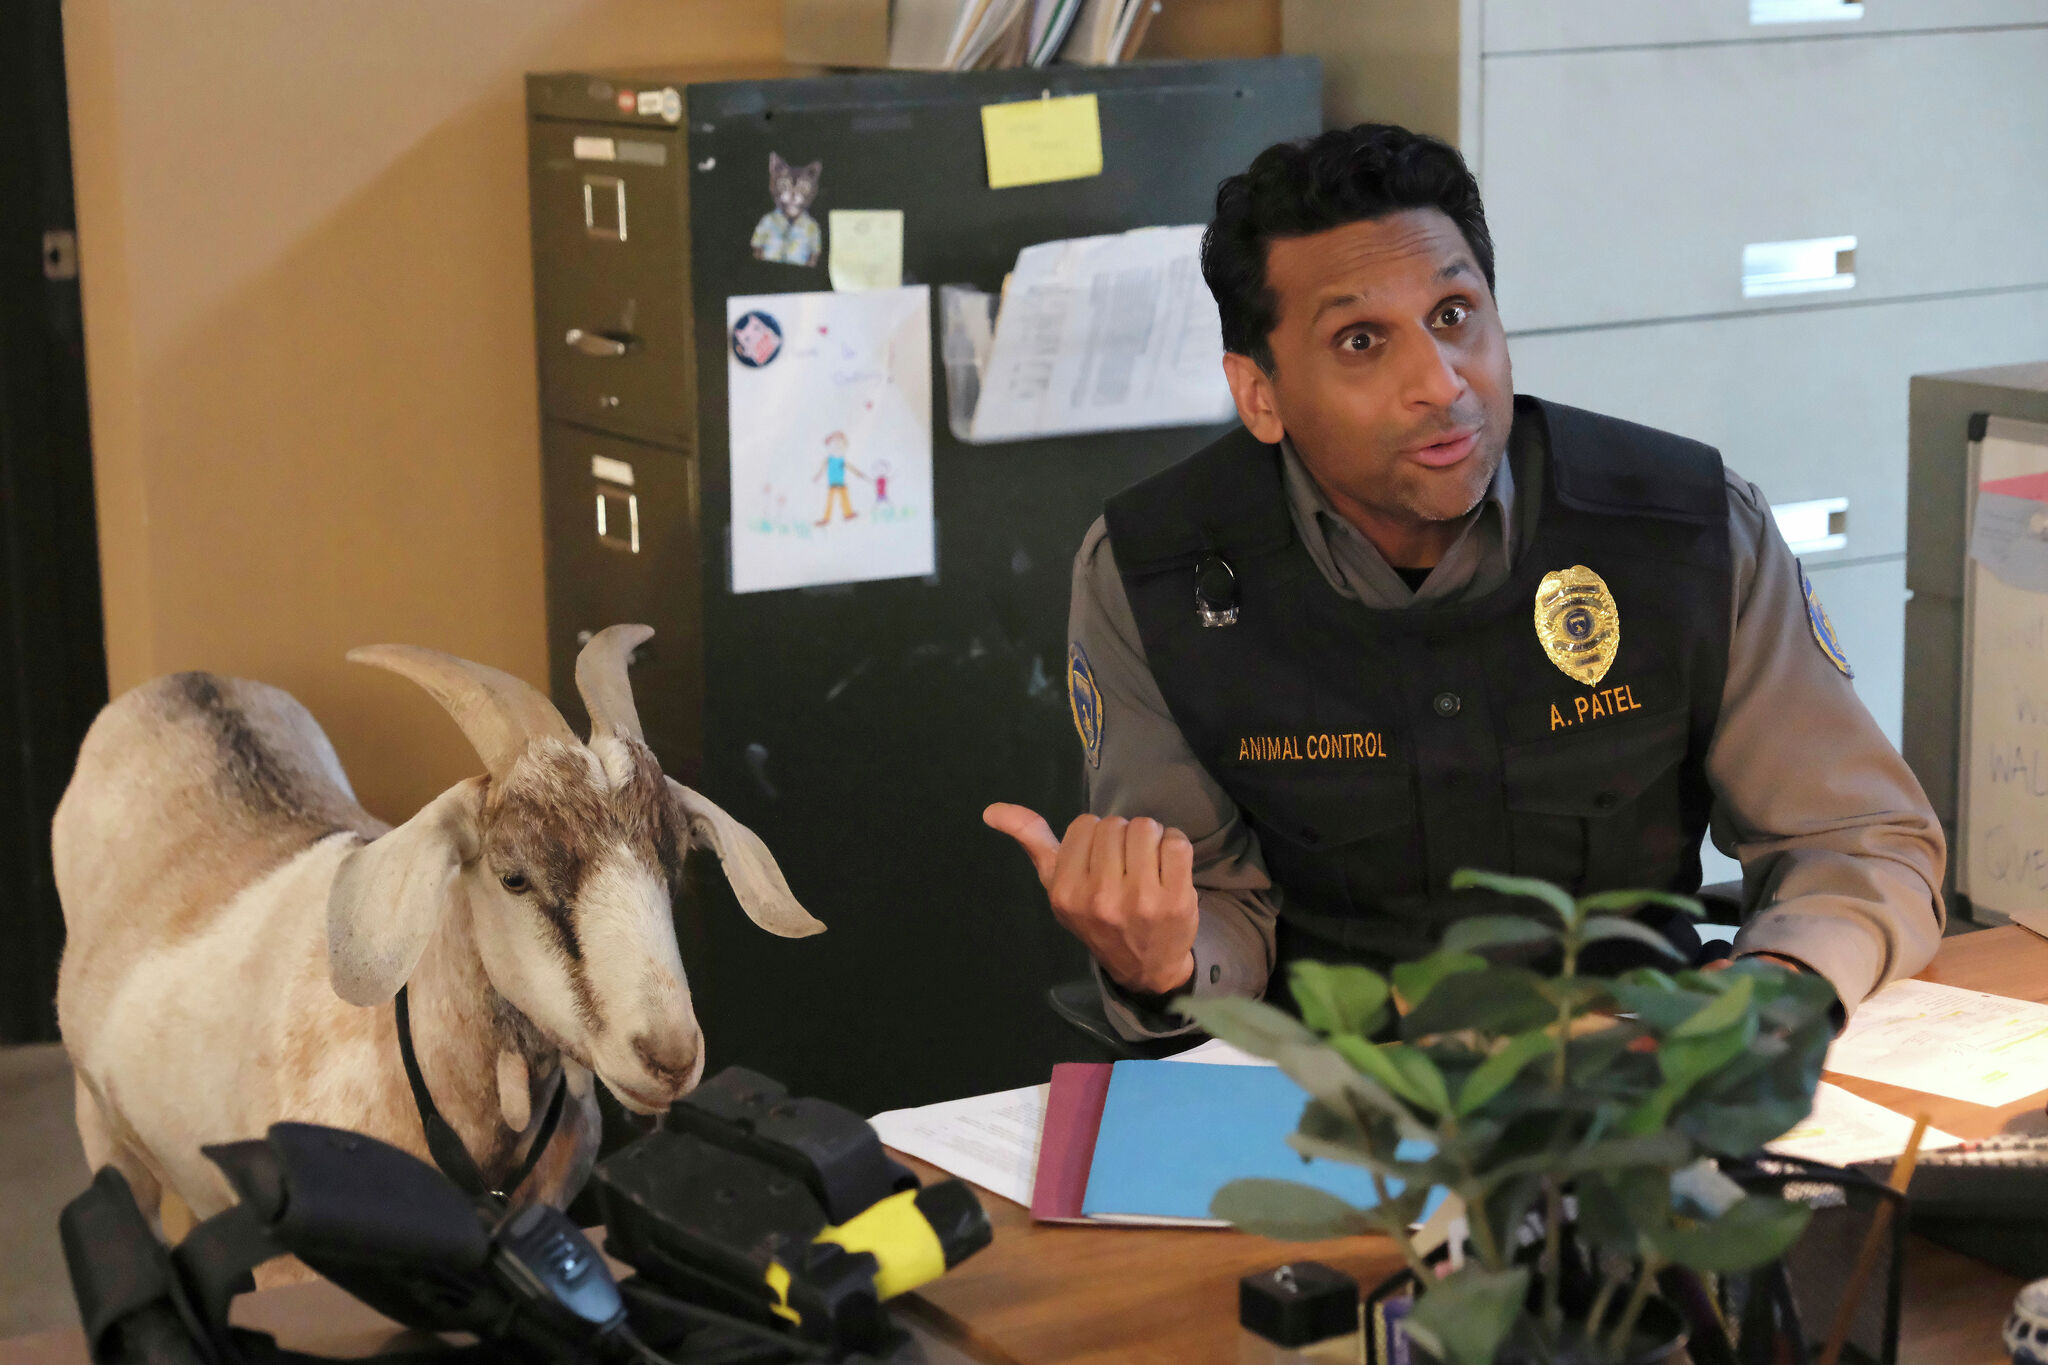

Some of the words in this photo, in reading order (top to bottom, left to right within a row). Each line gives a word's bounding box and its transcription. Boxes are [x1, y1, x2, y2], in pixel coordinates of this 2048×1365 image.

[1550, 703, 1573, 732] A.
[1573, 684, 1642, 724] PATEL
[1239, 735, 1304, 761] ANIMAL
[1306, 731, 1388, 761] CONTROL
